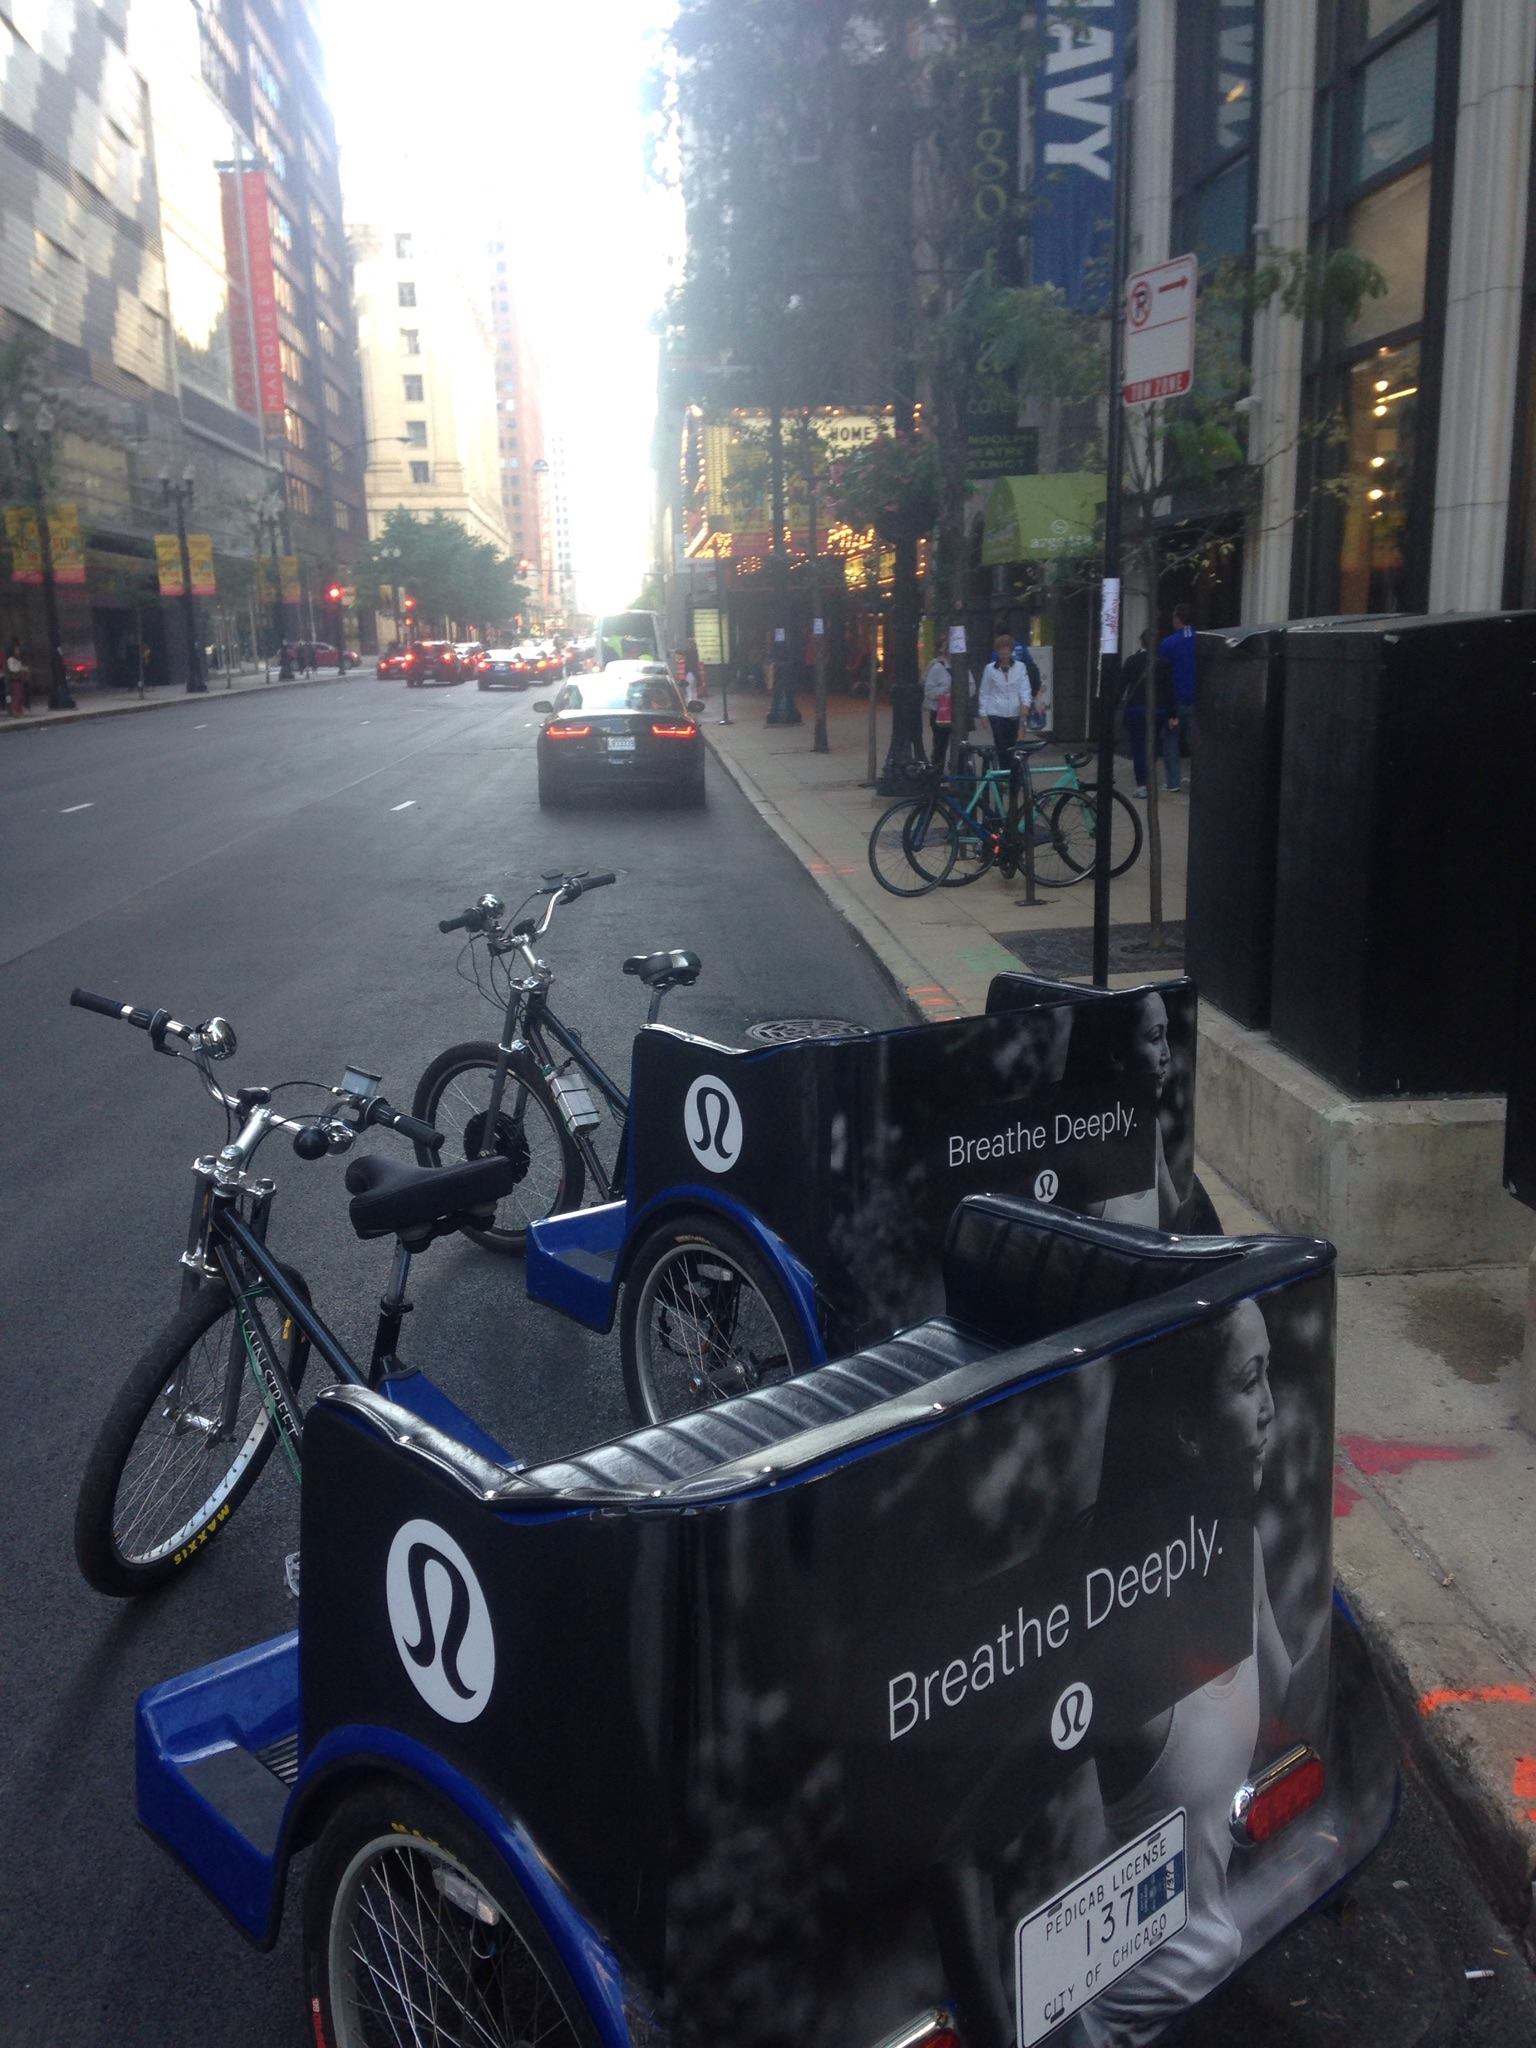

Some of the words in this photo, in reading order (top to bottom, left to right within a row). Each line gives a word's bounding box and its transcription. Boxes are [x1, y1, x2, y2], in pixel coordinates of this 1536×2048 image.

[1044, 0, 1115, 181] AVY
[972, 86, 1010, 222] rgo
[829, 426, 873, 442] HOME
[949, 1121, 1047, 1168] Breathe
[1055, 1101, 1138, 1145] Deeply.
[264, 1368, 300, 1437] STREET
[174, 1503, 231, 1566] MAXXIS
[887, 1603, 1070, 1742] Breathe
[1085, 1514, 1224, 1631] Deeply.
[1045, 1884, 1105, 1942] PEDICAB
[1112, 1837, 1168, 1893] LICENSE
[1085, 1885, 1135, 1957] 137
[1043, 1983, 1076, 2022] CITY
[1085, 1962, 1103, 1989] OF
[1112, 1912, 1168, 1968] CHICAGO
